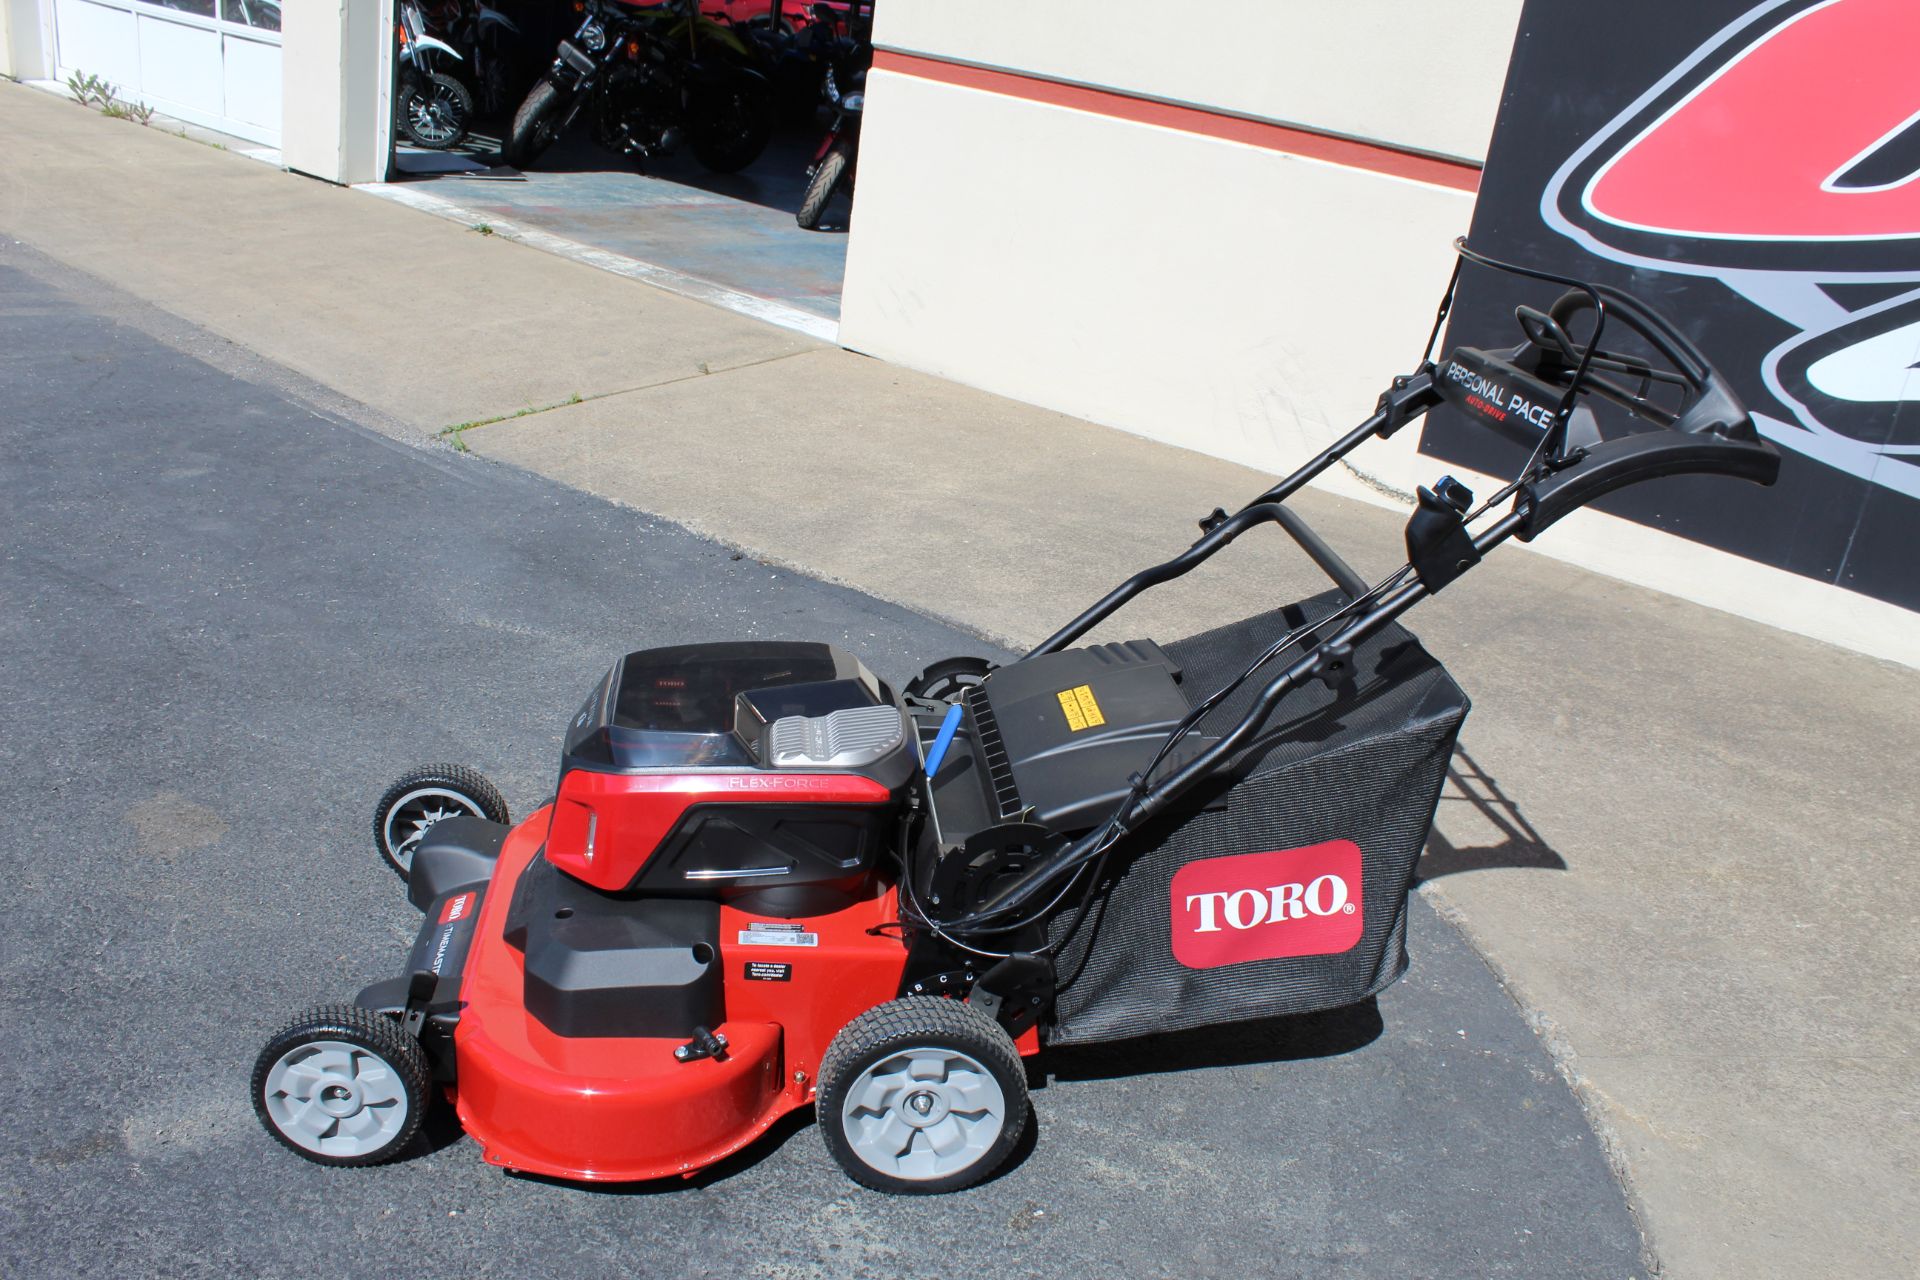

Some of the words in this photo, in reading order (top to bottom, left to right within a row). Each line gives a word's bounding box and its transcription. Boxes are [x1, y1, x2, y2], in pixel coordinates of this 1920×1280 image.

[1446, 362, 1505, 407] PERSONAL
[1508, 394, 1554, 430] PACE
[1465, 394, 1507, 421] AUTO-DRIVE
[729, 776, 830, 789] FLEX-FORCE
[448, 895, 467, 920] TORO
[1186, 874, 1348, 933] TORO
[940, 975, 947, 983] C
